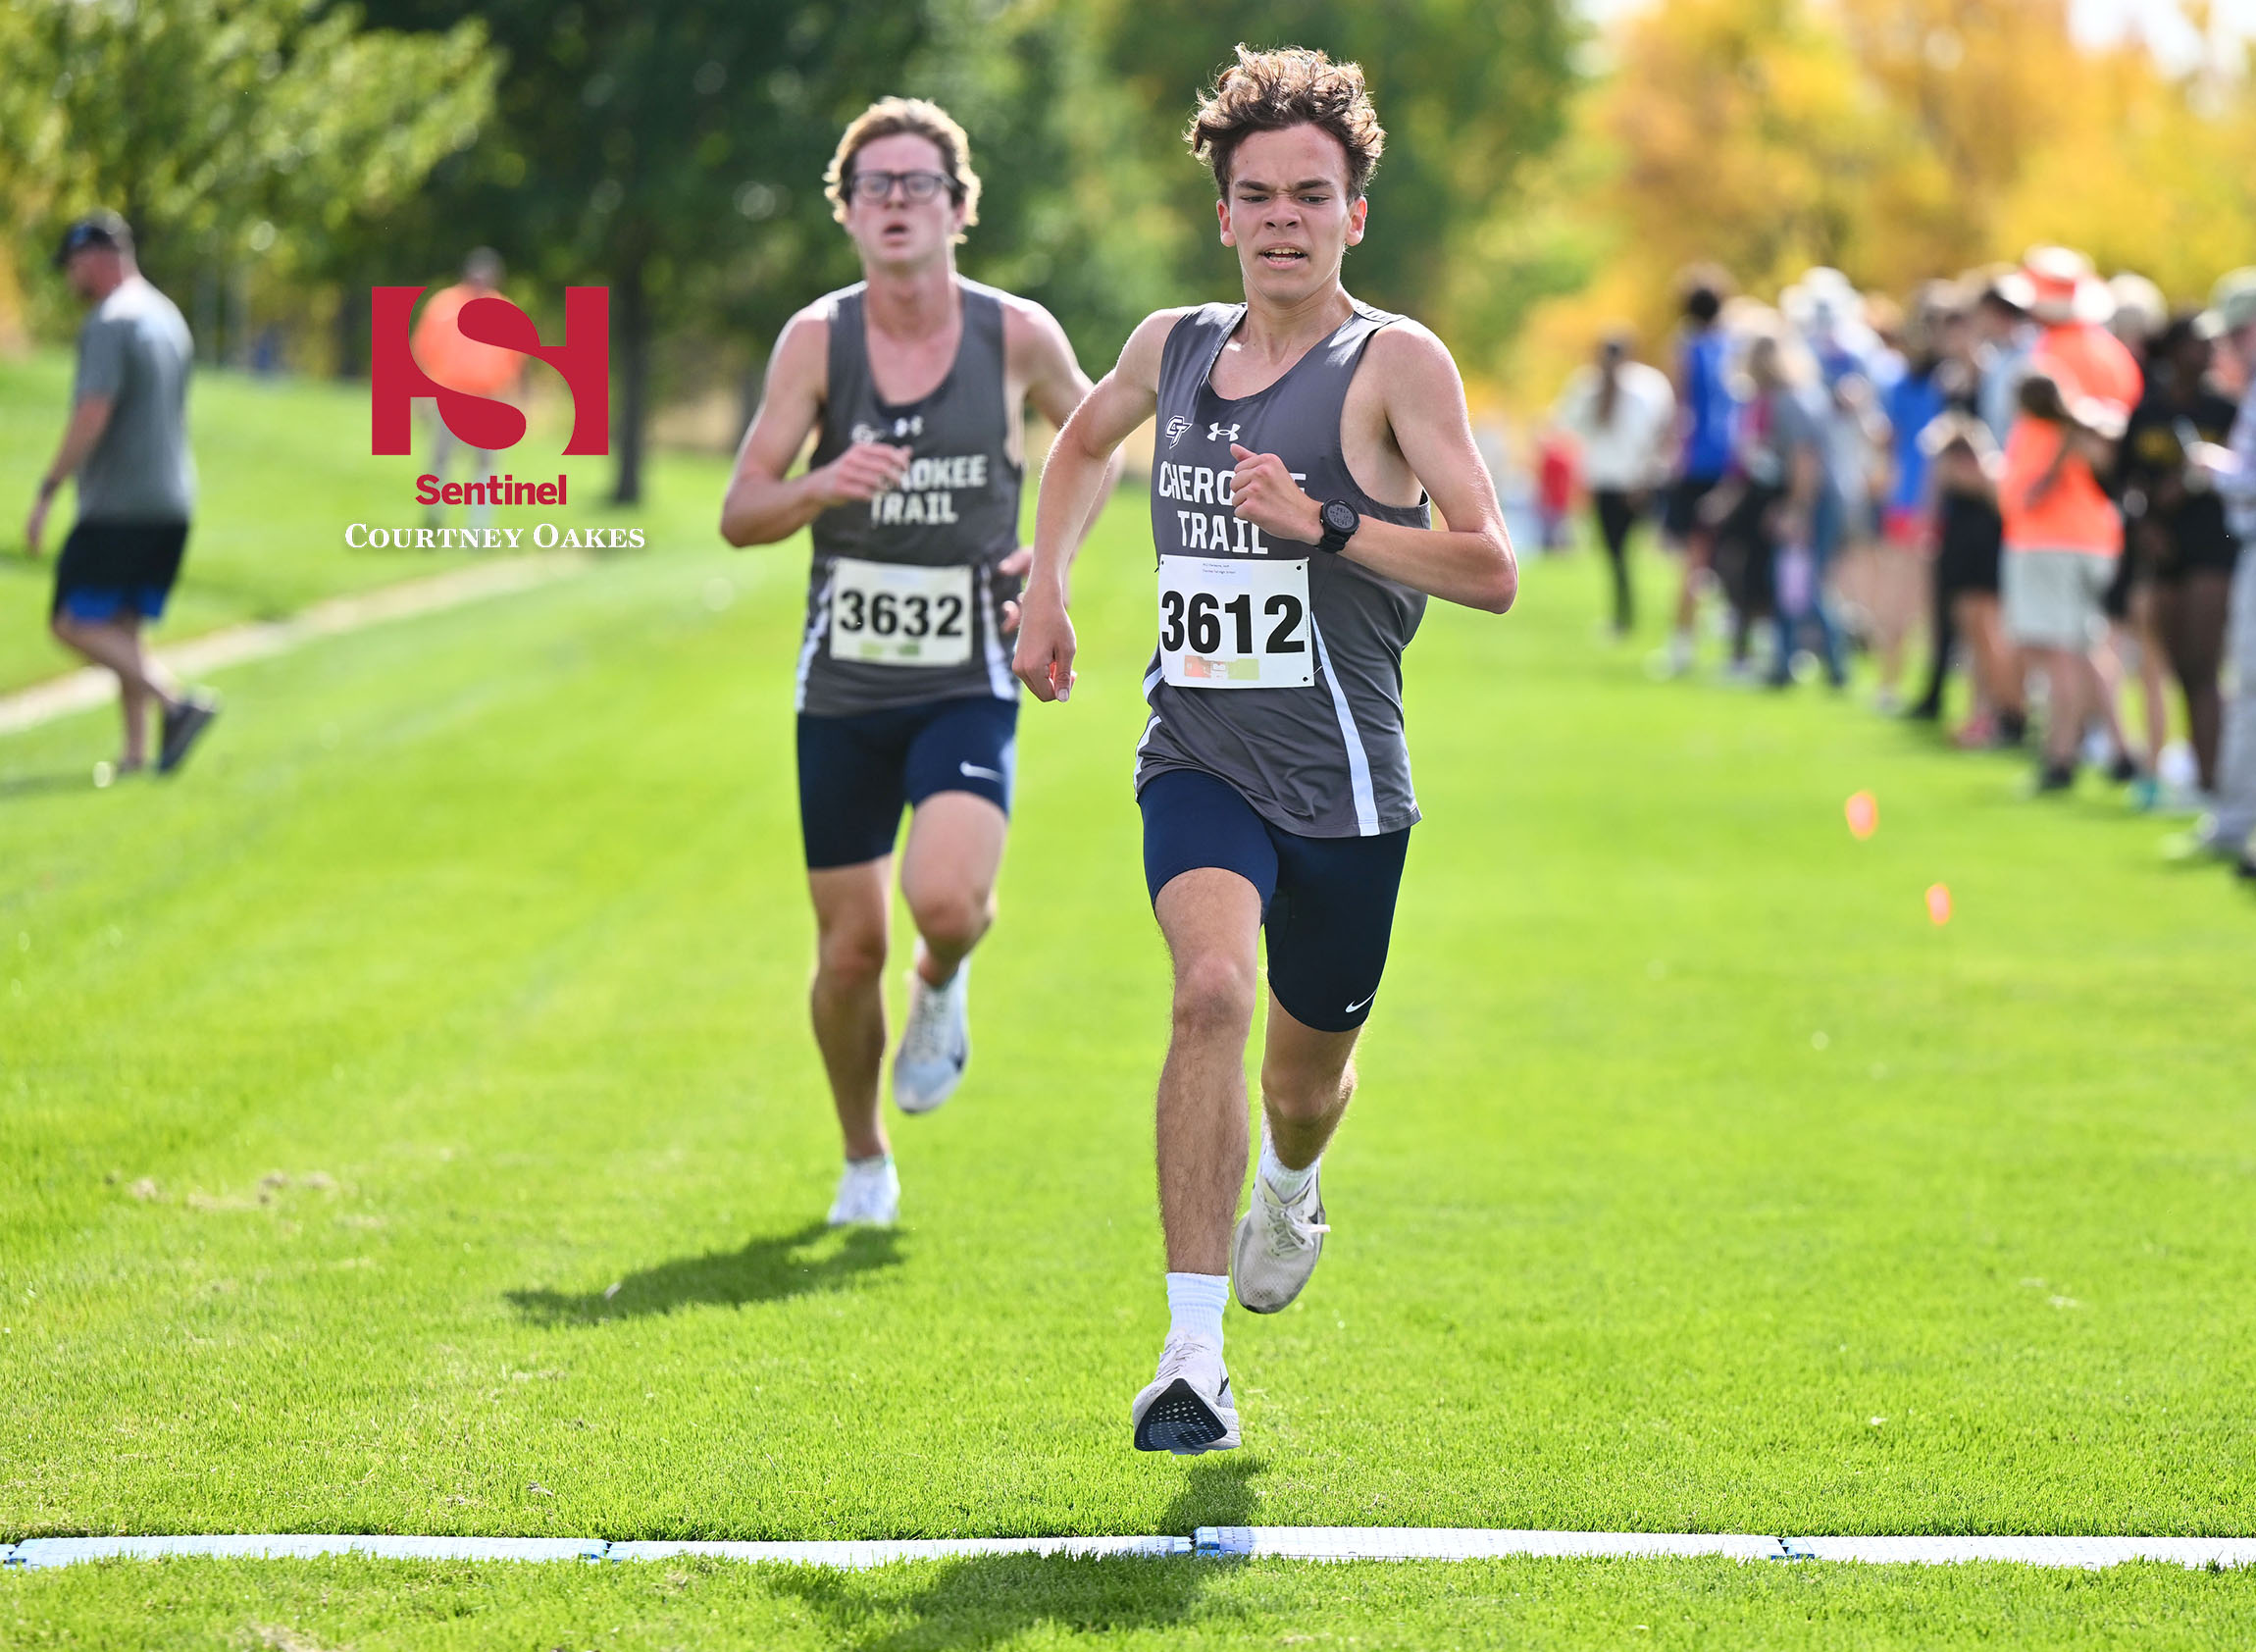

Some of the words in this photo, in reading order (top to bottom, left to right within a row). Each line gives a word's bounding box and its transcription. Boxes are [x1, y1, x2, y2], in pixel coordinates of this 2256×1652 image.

[1158, 461, 1307, 506] CHERO
[1177, 510, 1268, 554] TRAIL
[841, 590, 963, 637] 3632
[1161, 591, 1306, 654] 3612
